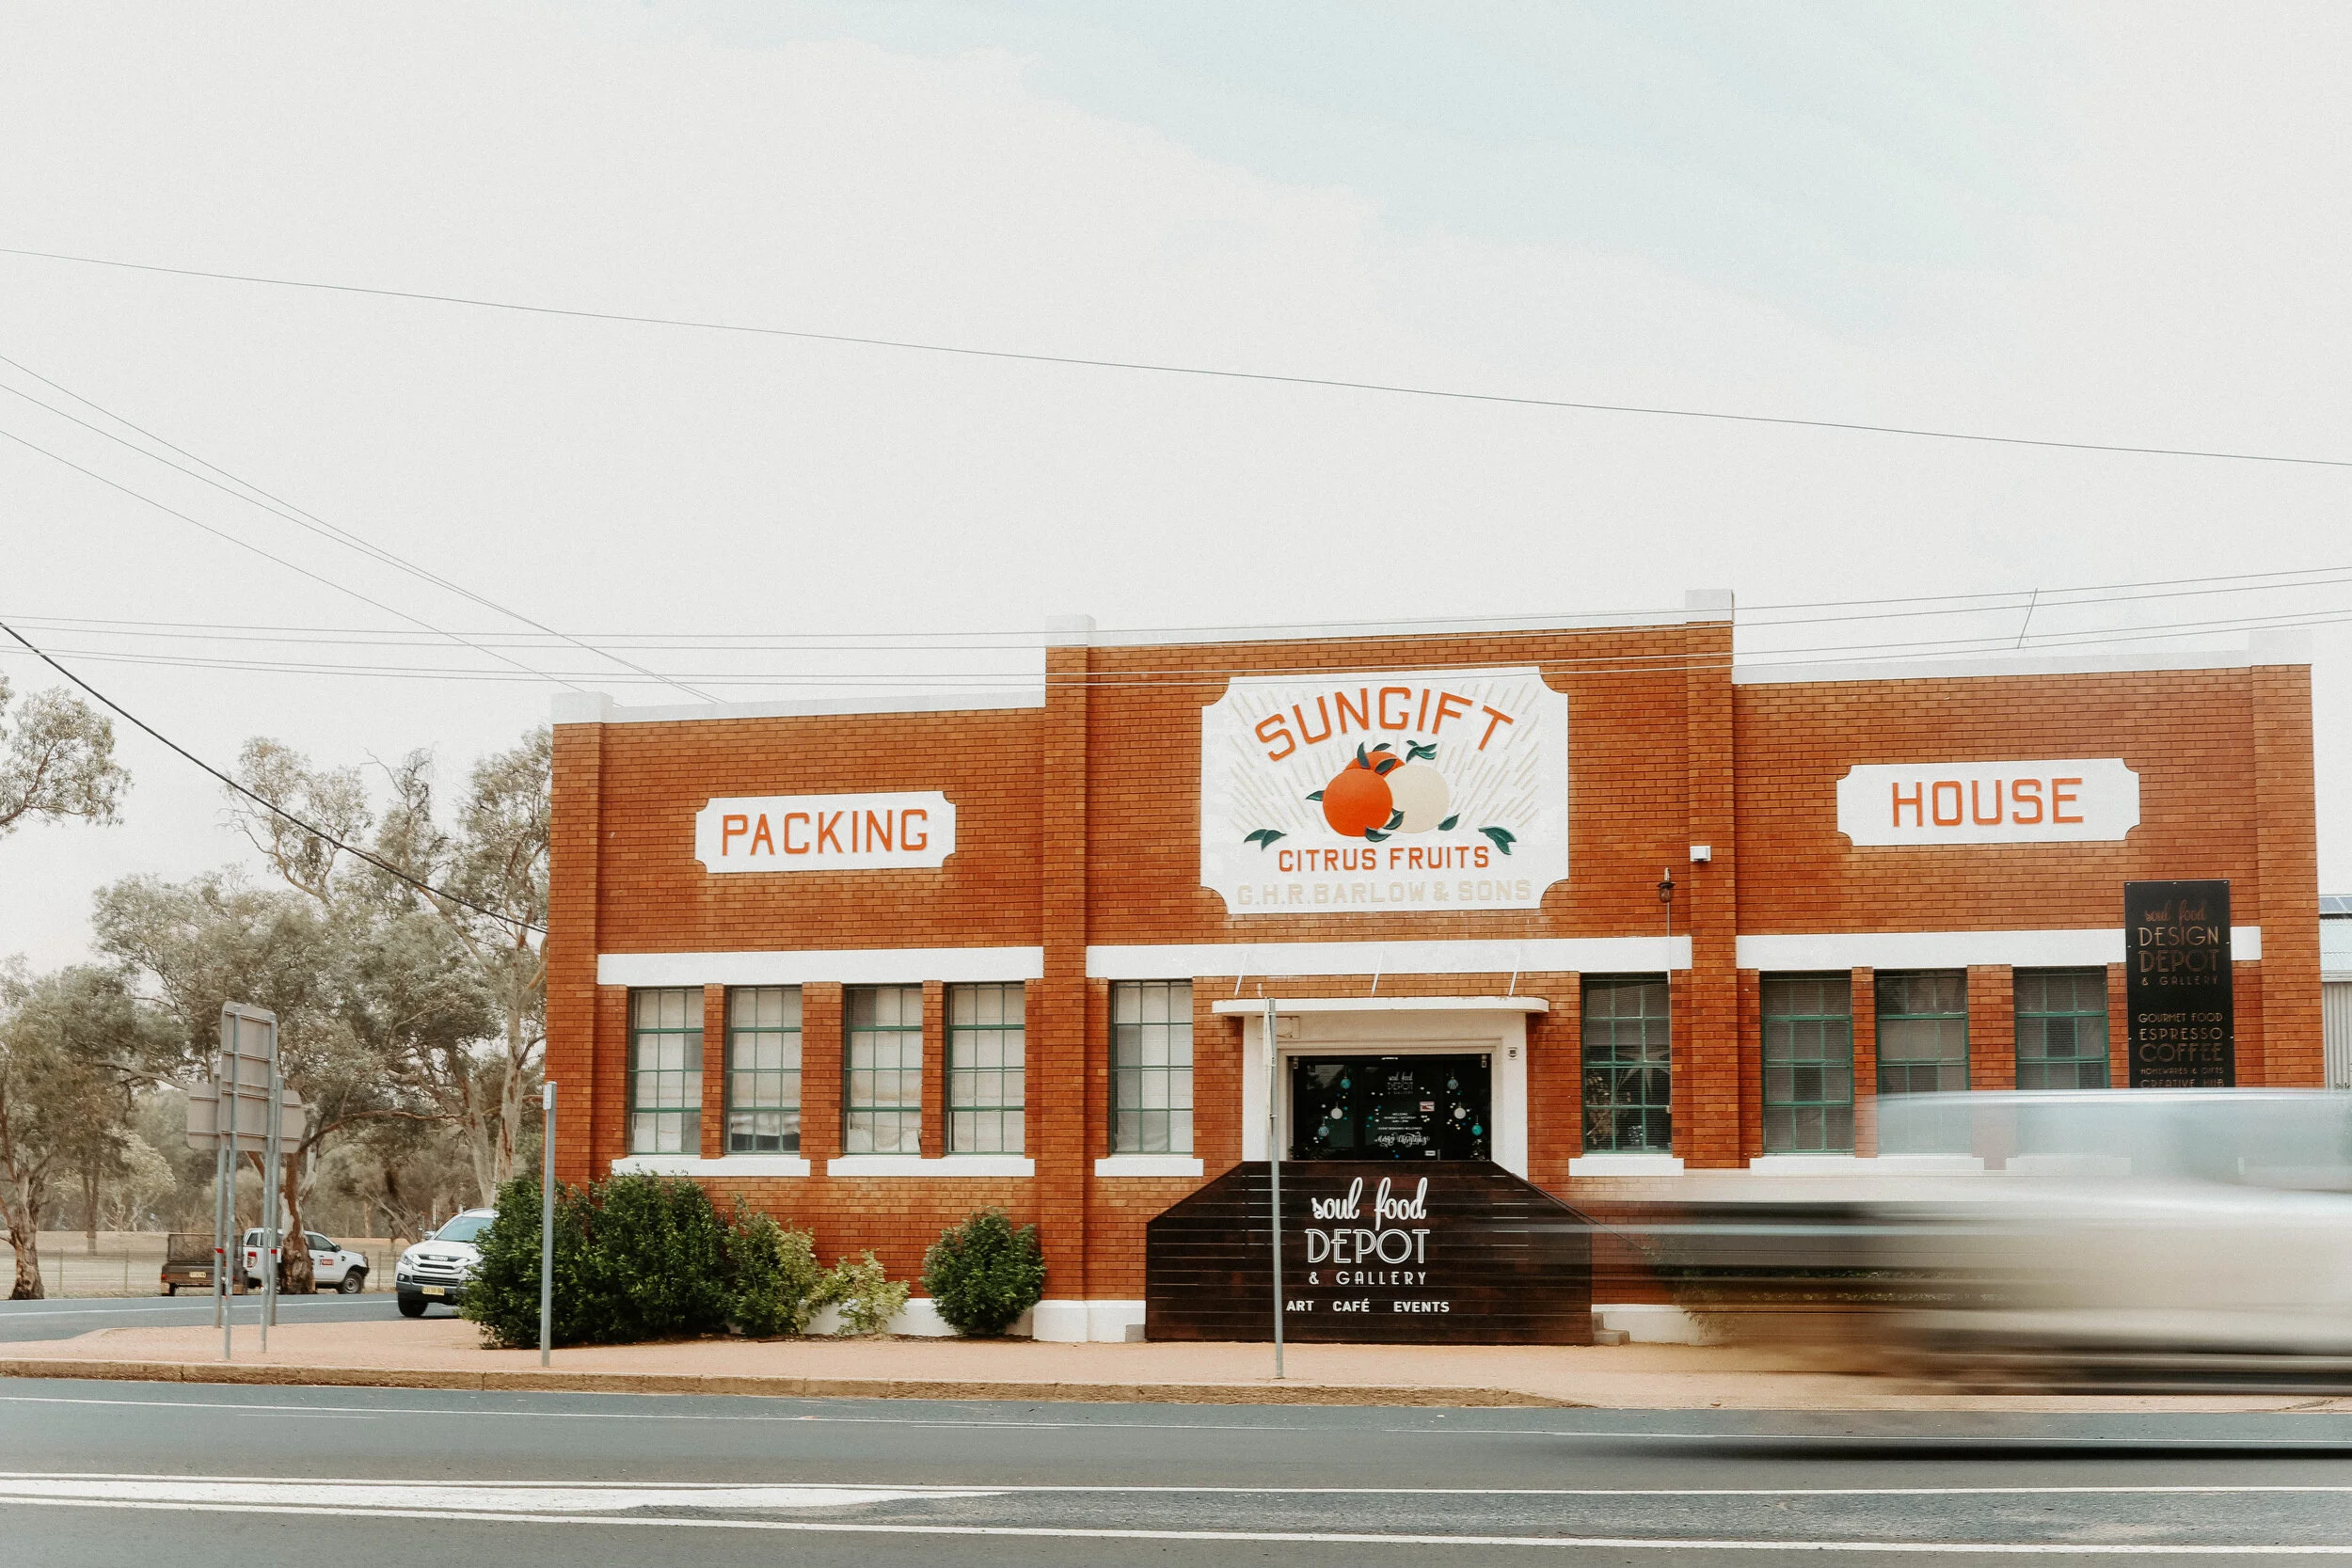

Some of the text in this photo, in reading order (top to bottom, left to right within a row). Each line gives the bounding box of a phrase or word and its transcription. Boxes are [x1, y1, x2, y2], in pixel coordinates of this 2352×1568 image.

[1254, 687, 1515, 763] SUNGIFT
[1892, 777, 2085, 828] HOUSE
[722, 808, 929, 857] PACKING
[1279, 846, 1489, 873] CITRUS FRUITS
[1433, 881, 1450, 901] &
[1457, 879, 1532, 901] SONS
[2137, 925, 2219, 947] DESIGN
[2137, 948, 2221, 973] DEPOT
[2137, 1012, 2223, 1023] GOURMET FOOD
[2138, 1026, 2223, 1041] ESPRESSO
[2138, 1042, 2224, 1063] COFFEE
[1311, 1177, 1428, 1231] soul food
[1304, 1228, 1431, 1263] DEPOT
[1309, 1271, 1426, 1285] & GALLERY
[1286, 1298, 1450, 1312] ART CAFÉ EVENTS
